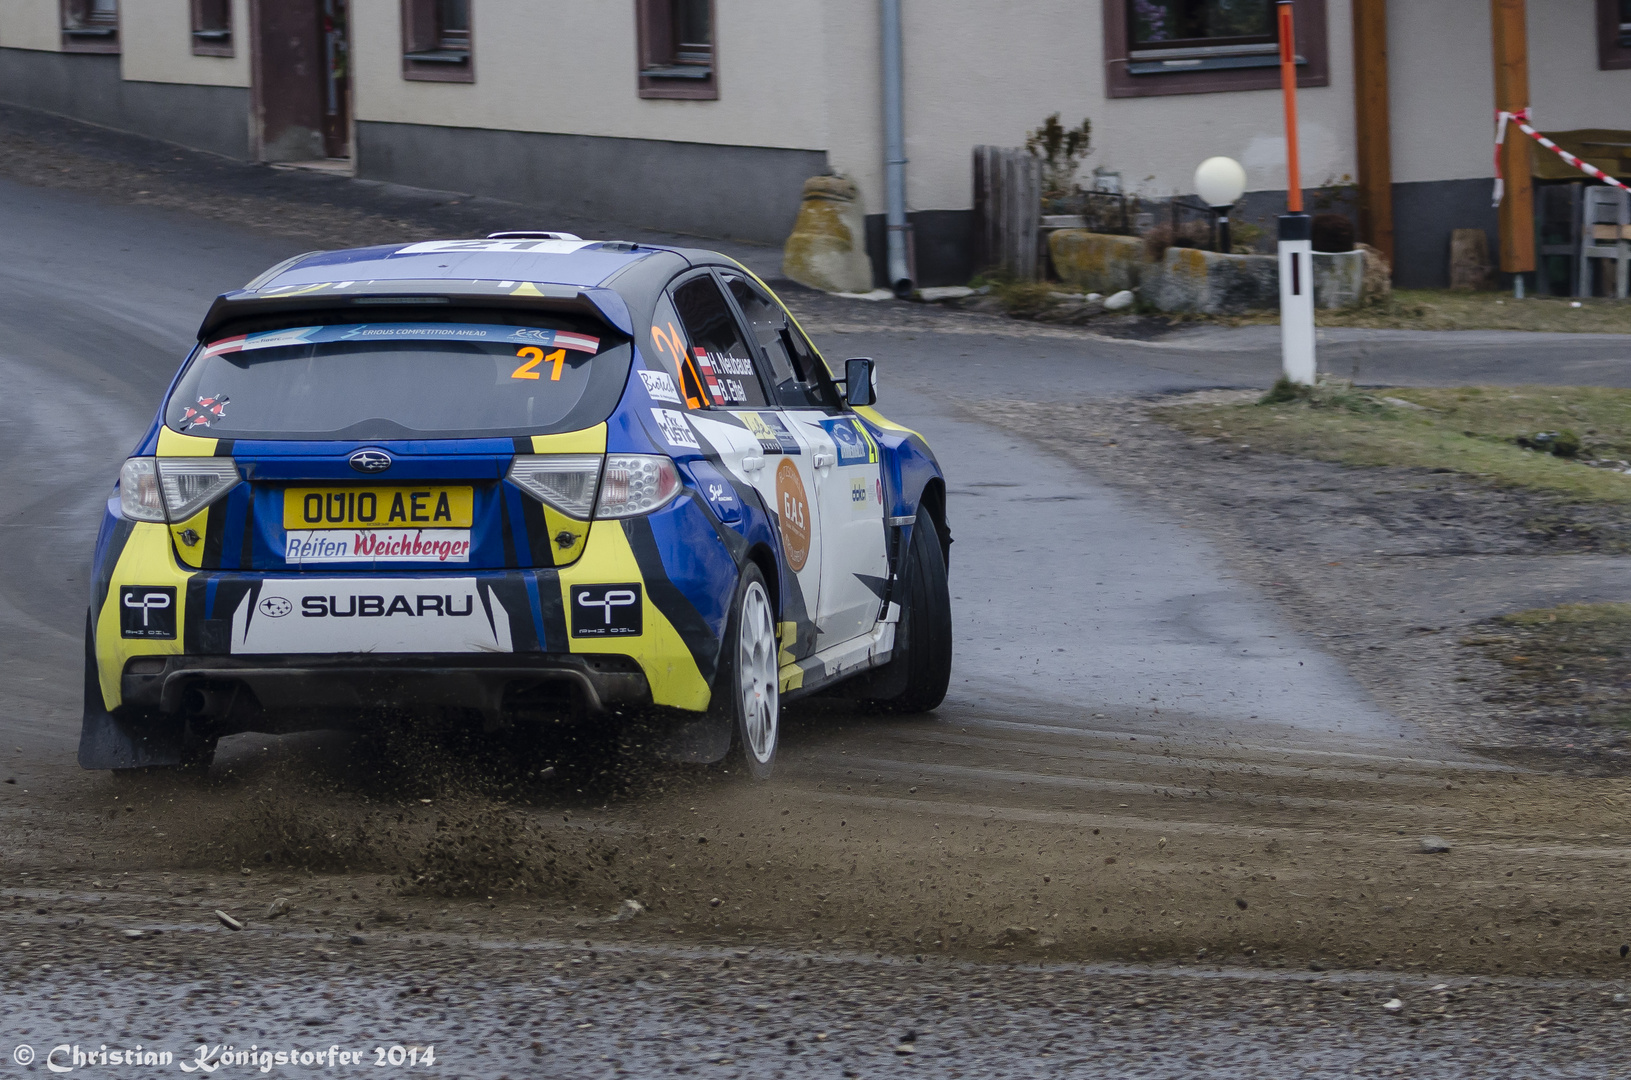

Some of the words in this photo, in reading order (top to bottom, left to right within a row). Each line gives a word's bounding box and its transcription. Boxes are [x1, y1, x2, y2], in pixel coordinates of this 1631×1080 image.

[395, 328, 455, 336] COMPETITION
[455, 329, 487, 337] AHEAD
[506, 328, 550, 341] ERC
[511, 346, 566, 381] 21
[651, 322, 710, 410] 21
[706, 352, 722, 374] H.
[716, 352, 754, 375] Neubauer
[717, 379, 732, 401] B.
[851, 419, 878, 463] 21
[303, 492, 377, 523] OU10
[388, 491, 452, 522] AEA
[287, 537, 347, 557] Reifen
[353, 532, 469, 561] Weichberger
[301, 595, 473, 617] SUBARU
